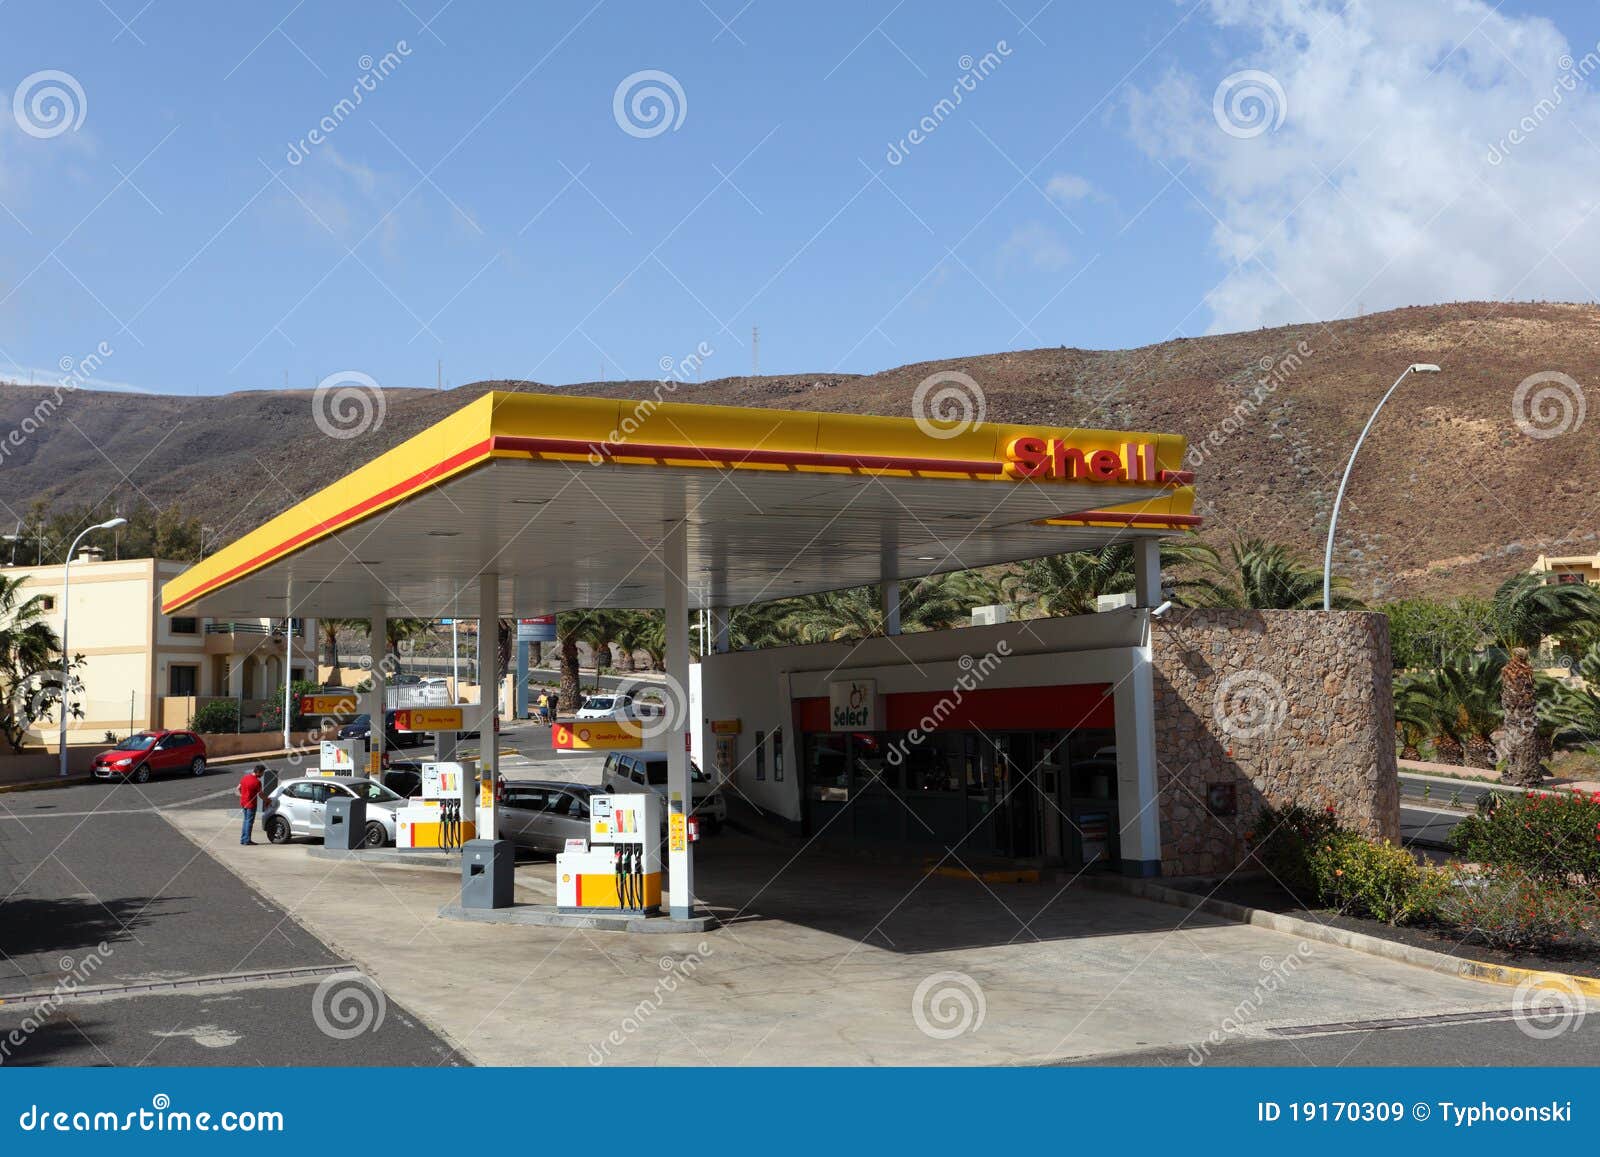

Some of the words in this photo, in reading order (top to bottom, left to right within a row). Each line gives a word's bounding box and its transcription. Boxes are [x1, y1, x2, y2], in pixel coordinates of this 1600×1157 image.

[1006, 437, 1156, 481] Shell
[303, 699, 312, 711] 2
[833, 705, 868, 726] Select
[557, 727, 569, 745] 6
